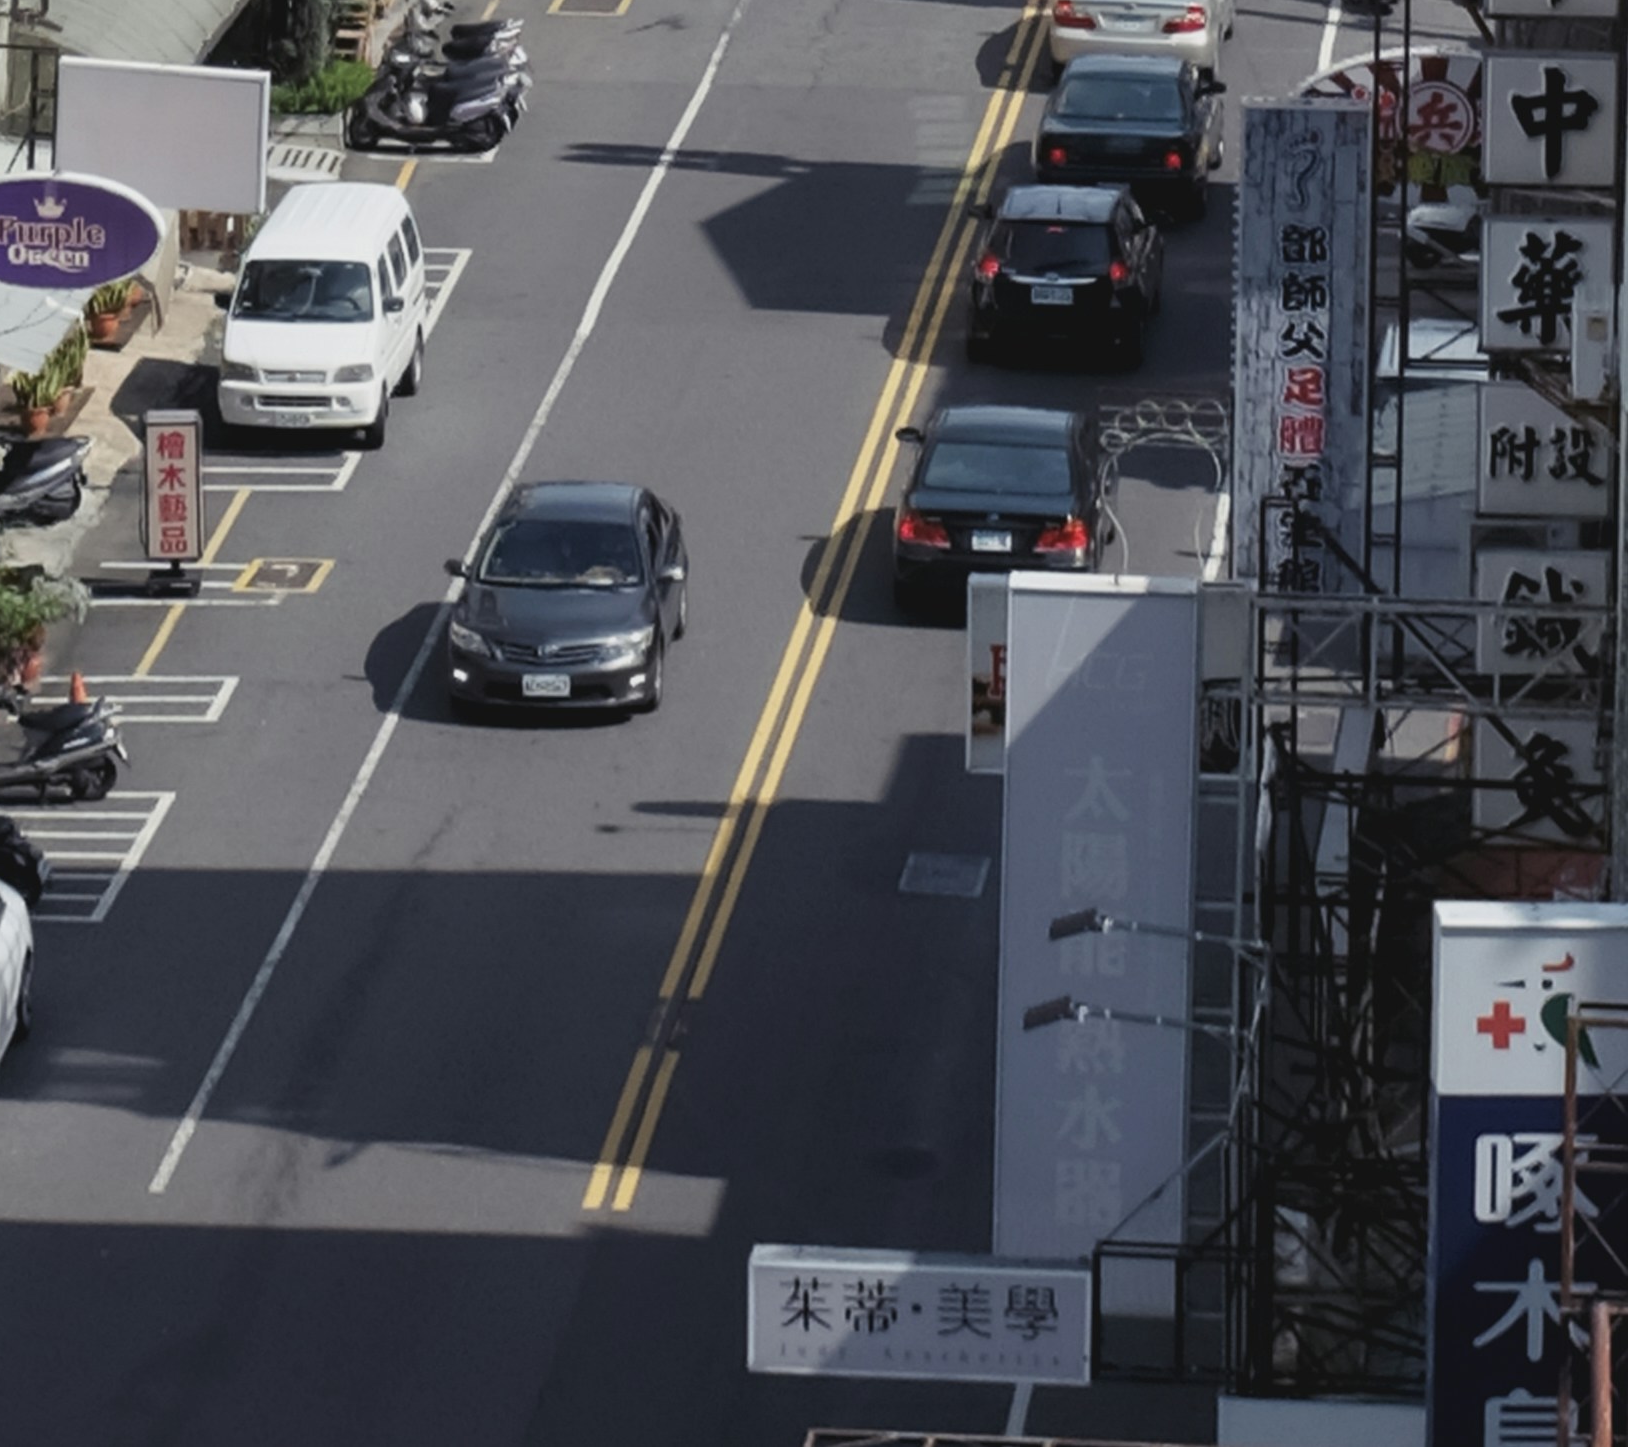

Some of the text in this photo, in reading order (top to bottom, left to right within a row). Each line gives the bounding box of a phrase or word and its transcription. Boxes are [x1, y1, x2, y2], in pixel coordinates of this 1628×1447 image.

[1405, 90, 1465, 152] 兵
[7, 243, 90, 274] Queen
[1488, 425, 1605, 487] 附設
